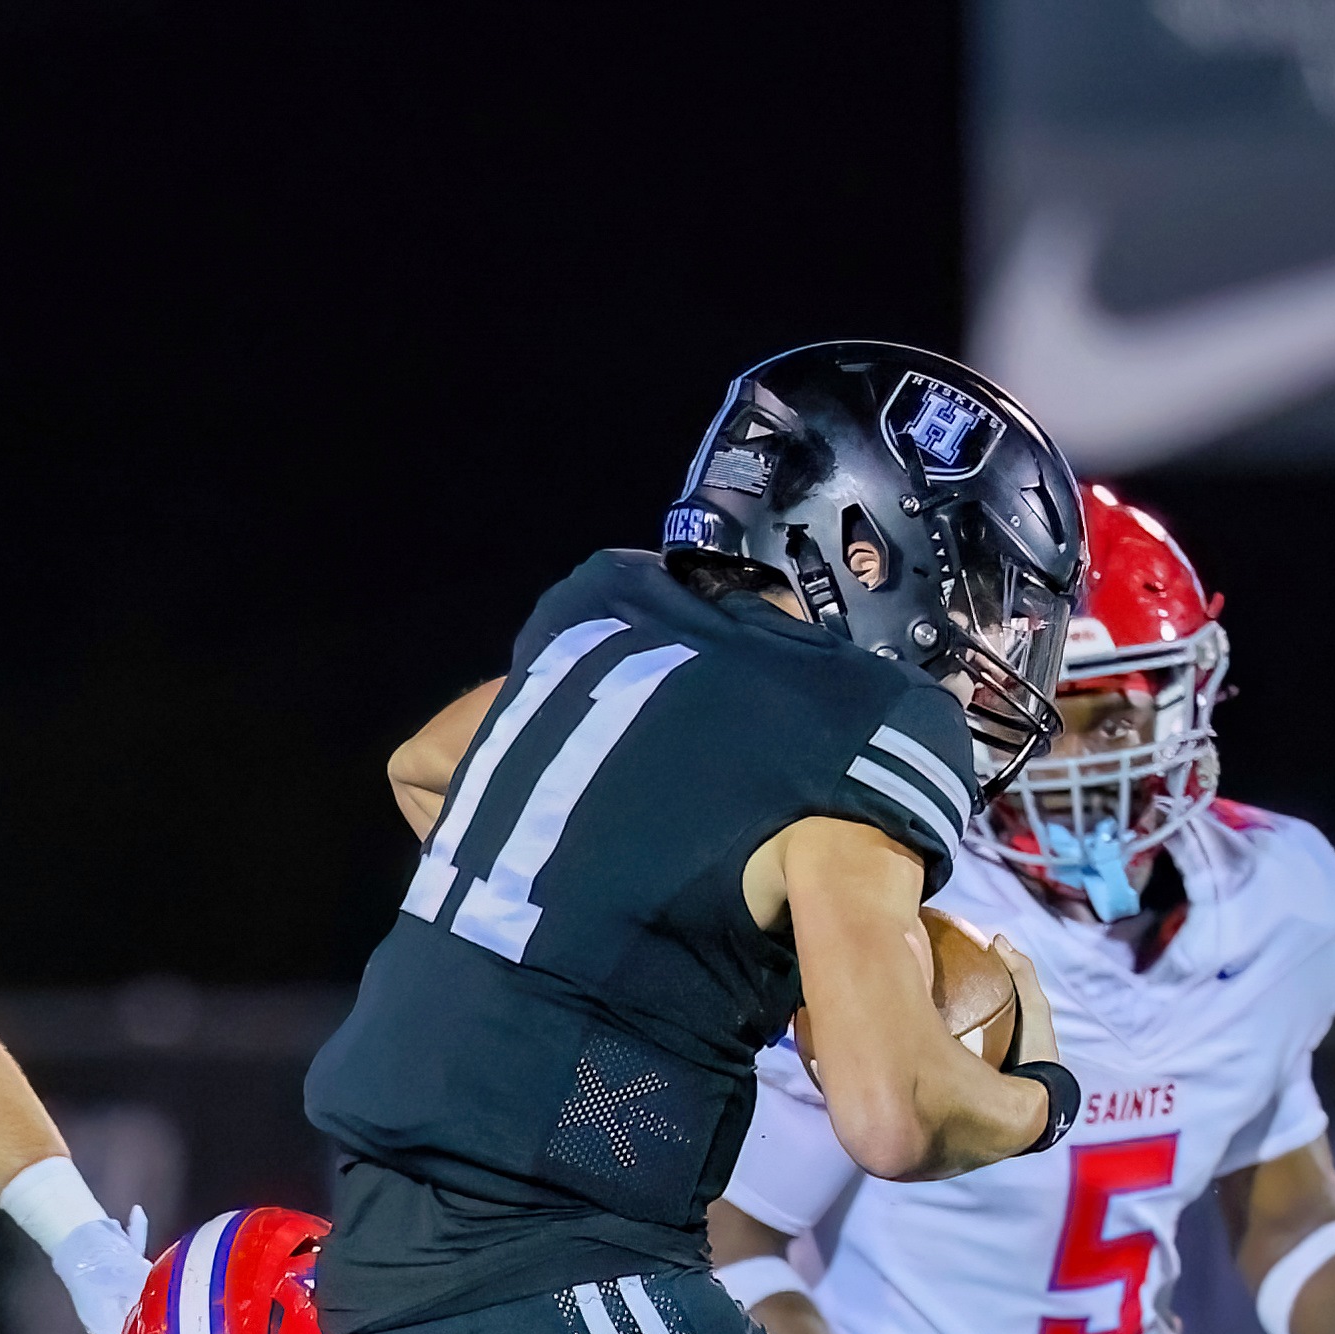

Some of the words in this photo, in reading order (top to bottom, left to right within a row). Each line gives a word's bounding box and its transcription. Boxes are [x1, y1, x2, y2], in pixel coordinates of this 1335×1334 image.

[902, 388, 981, 467] H
[911, 376, 999, 430] HUSKIES
[399, 617, 700, 965] 11
[1084, 1083, 1176, 1125] SAINTS
